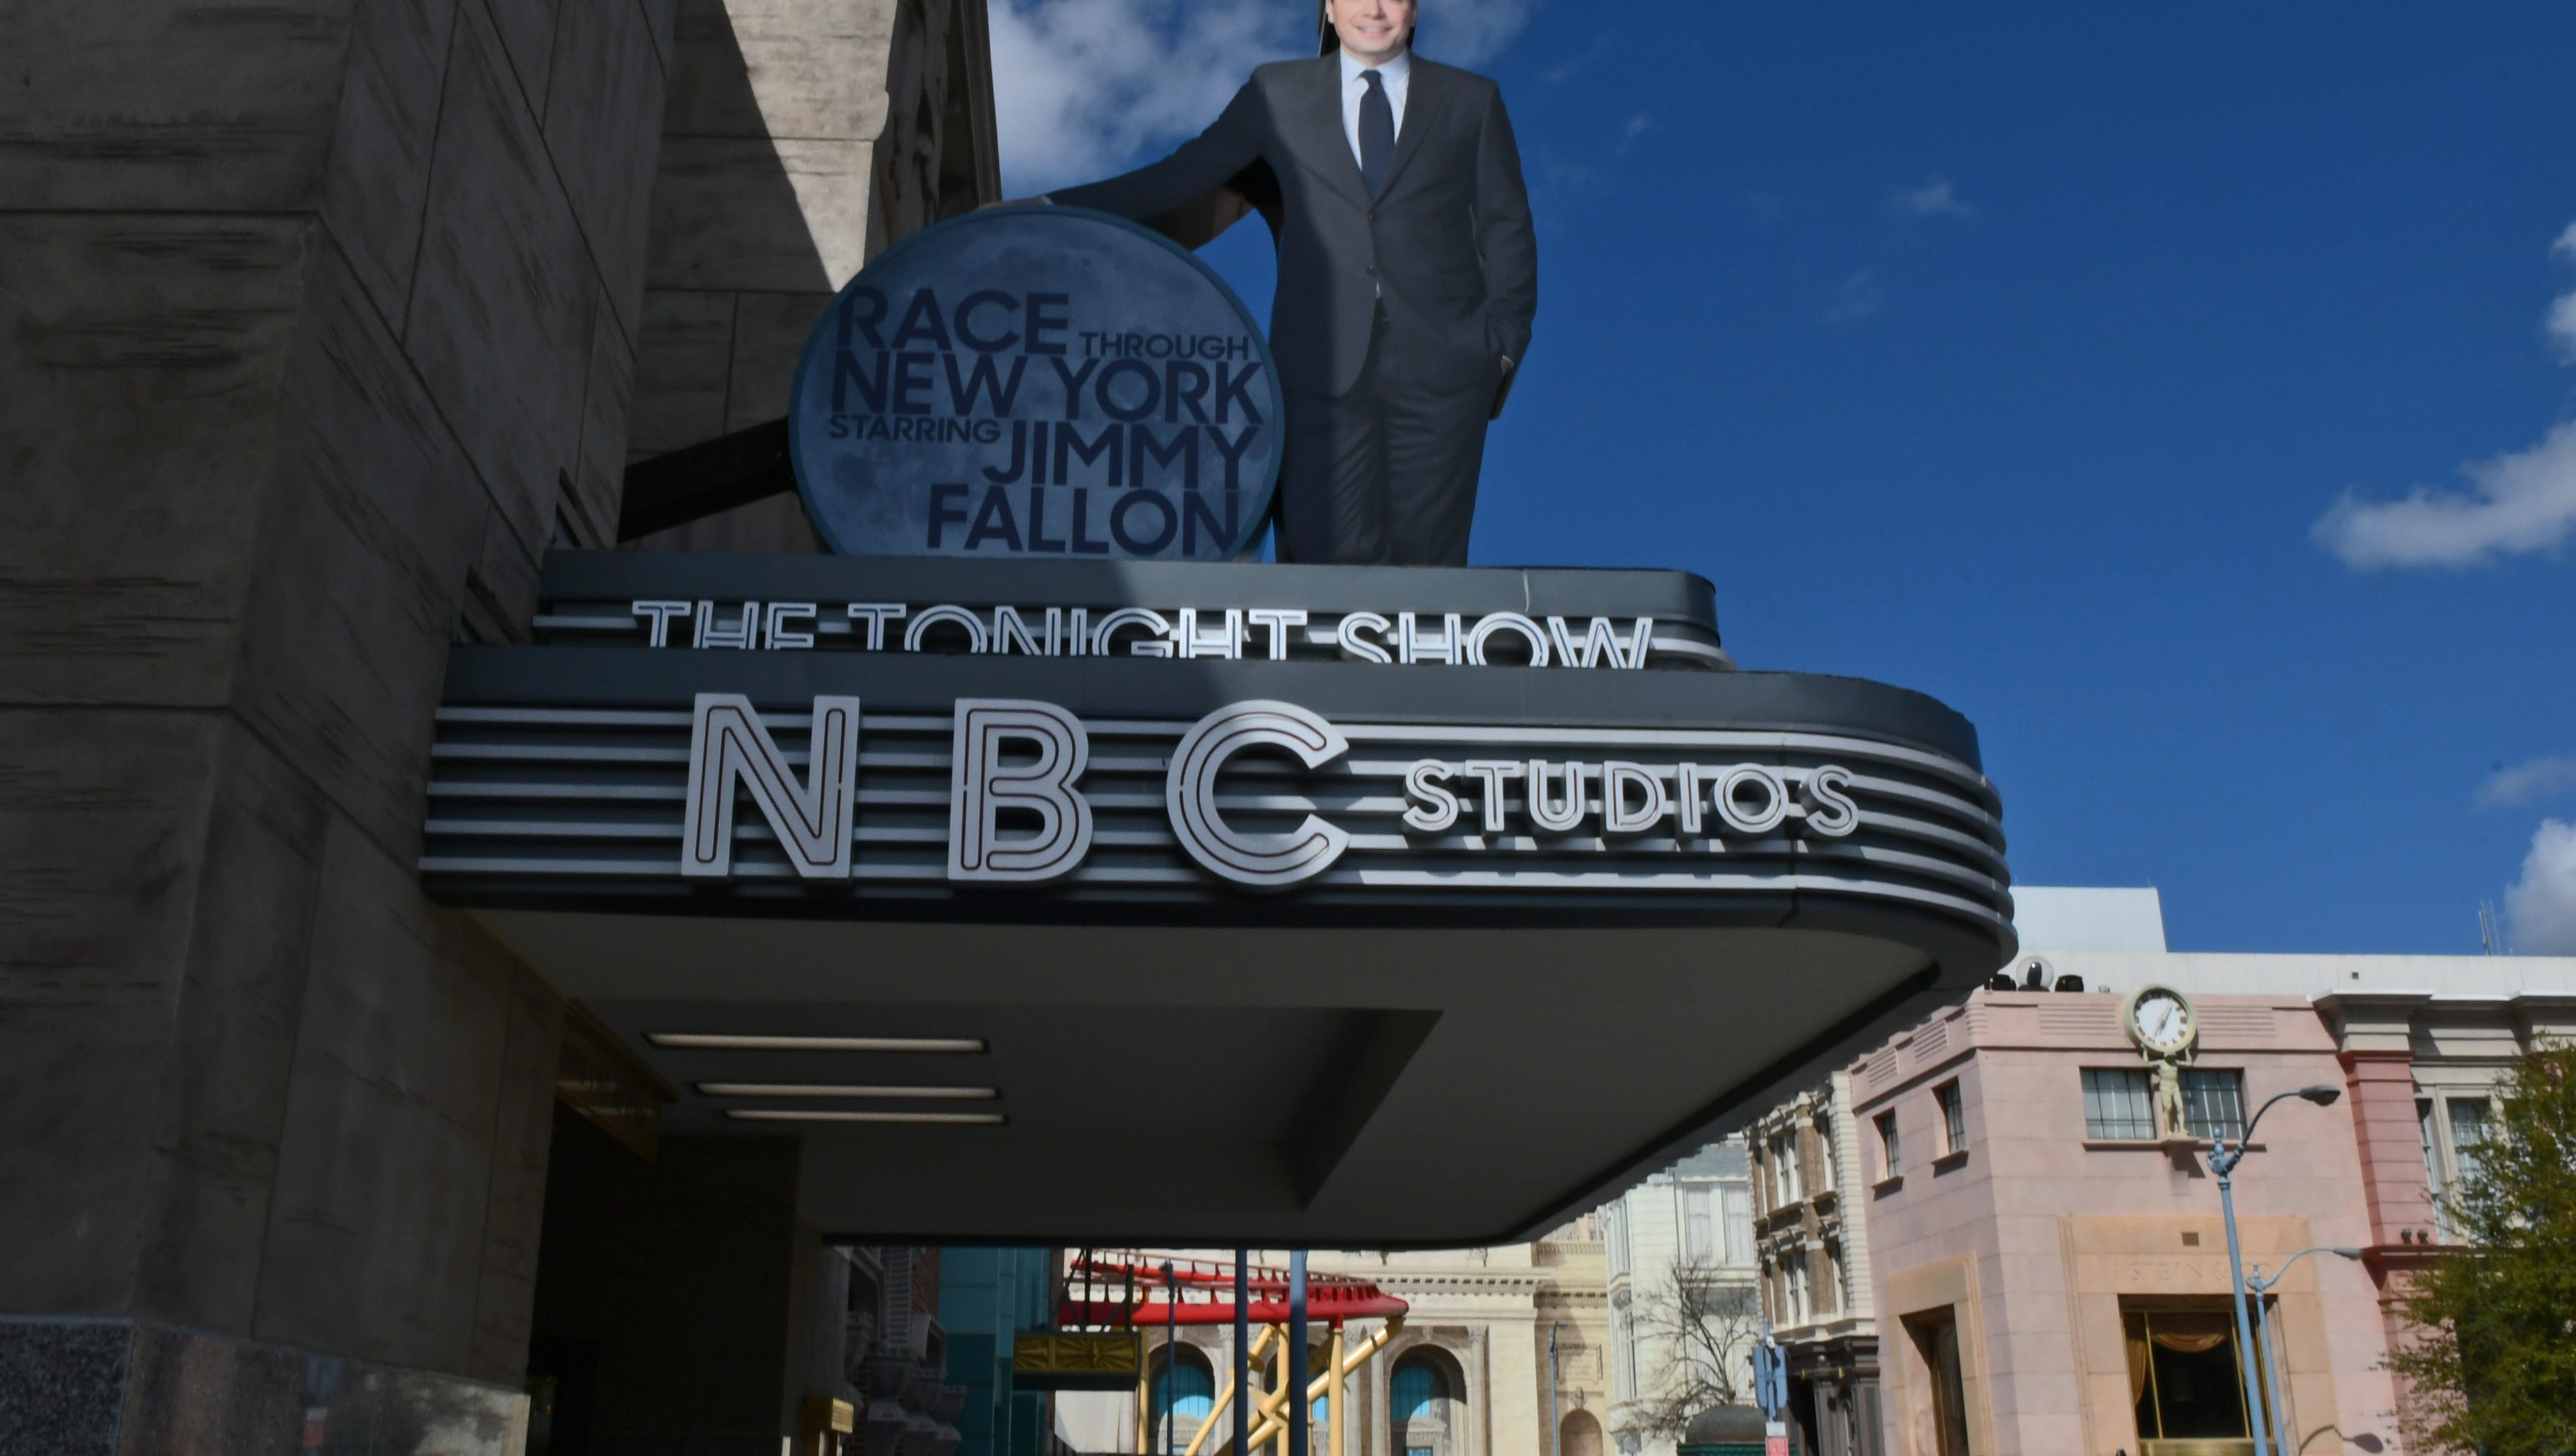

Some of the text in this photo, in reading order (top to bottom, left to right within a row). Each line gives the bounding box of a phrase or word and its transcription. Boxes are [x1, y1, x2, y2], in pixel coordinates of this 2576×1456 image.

[837, 285, 1249, 360] RACE THROUGH
[832, 349, 1265, 424] NEW YORK
[828, 414, 1261, 490] STARRING JIMMY
[927, 483, 1239, 556] FALLON
[632, 600, 1653, 669] THE TONIGHT SHOW
[680, 692, 1861, 887] NBC STUDIOS
